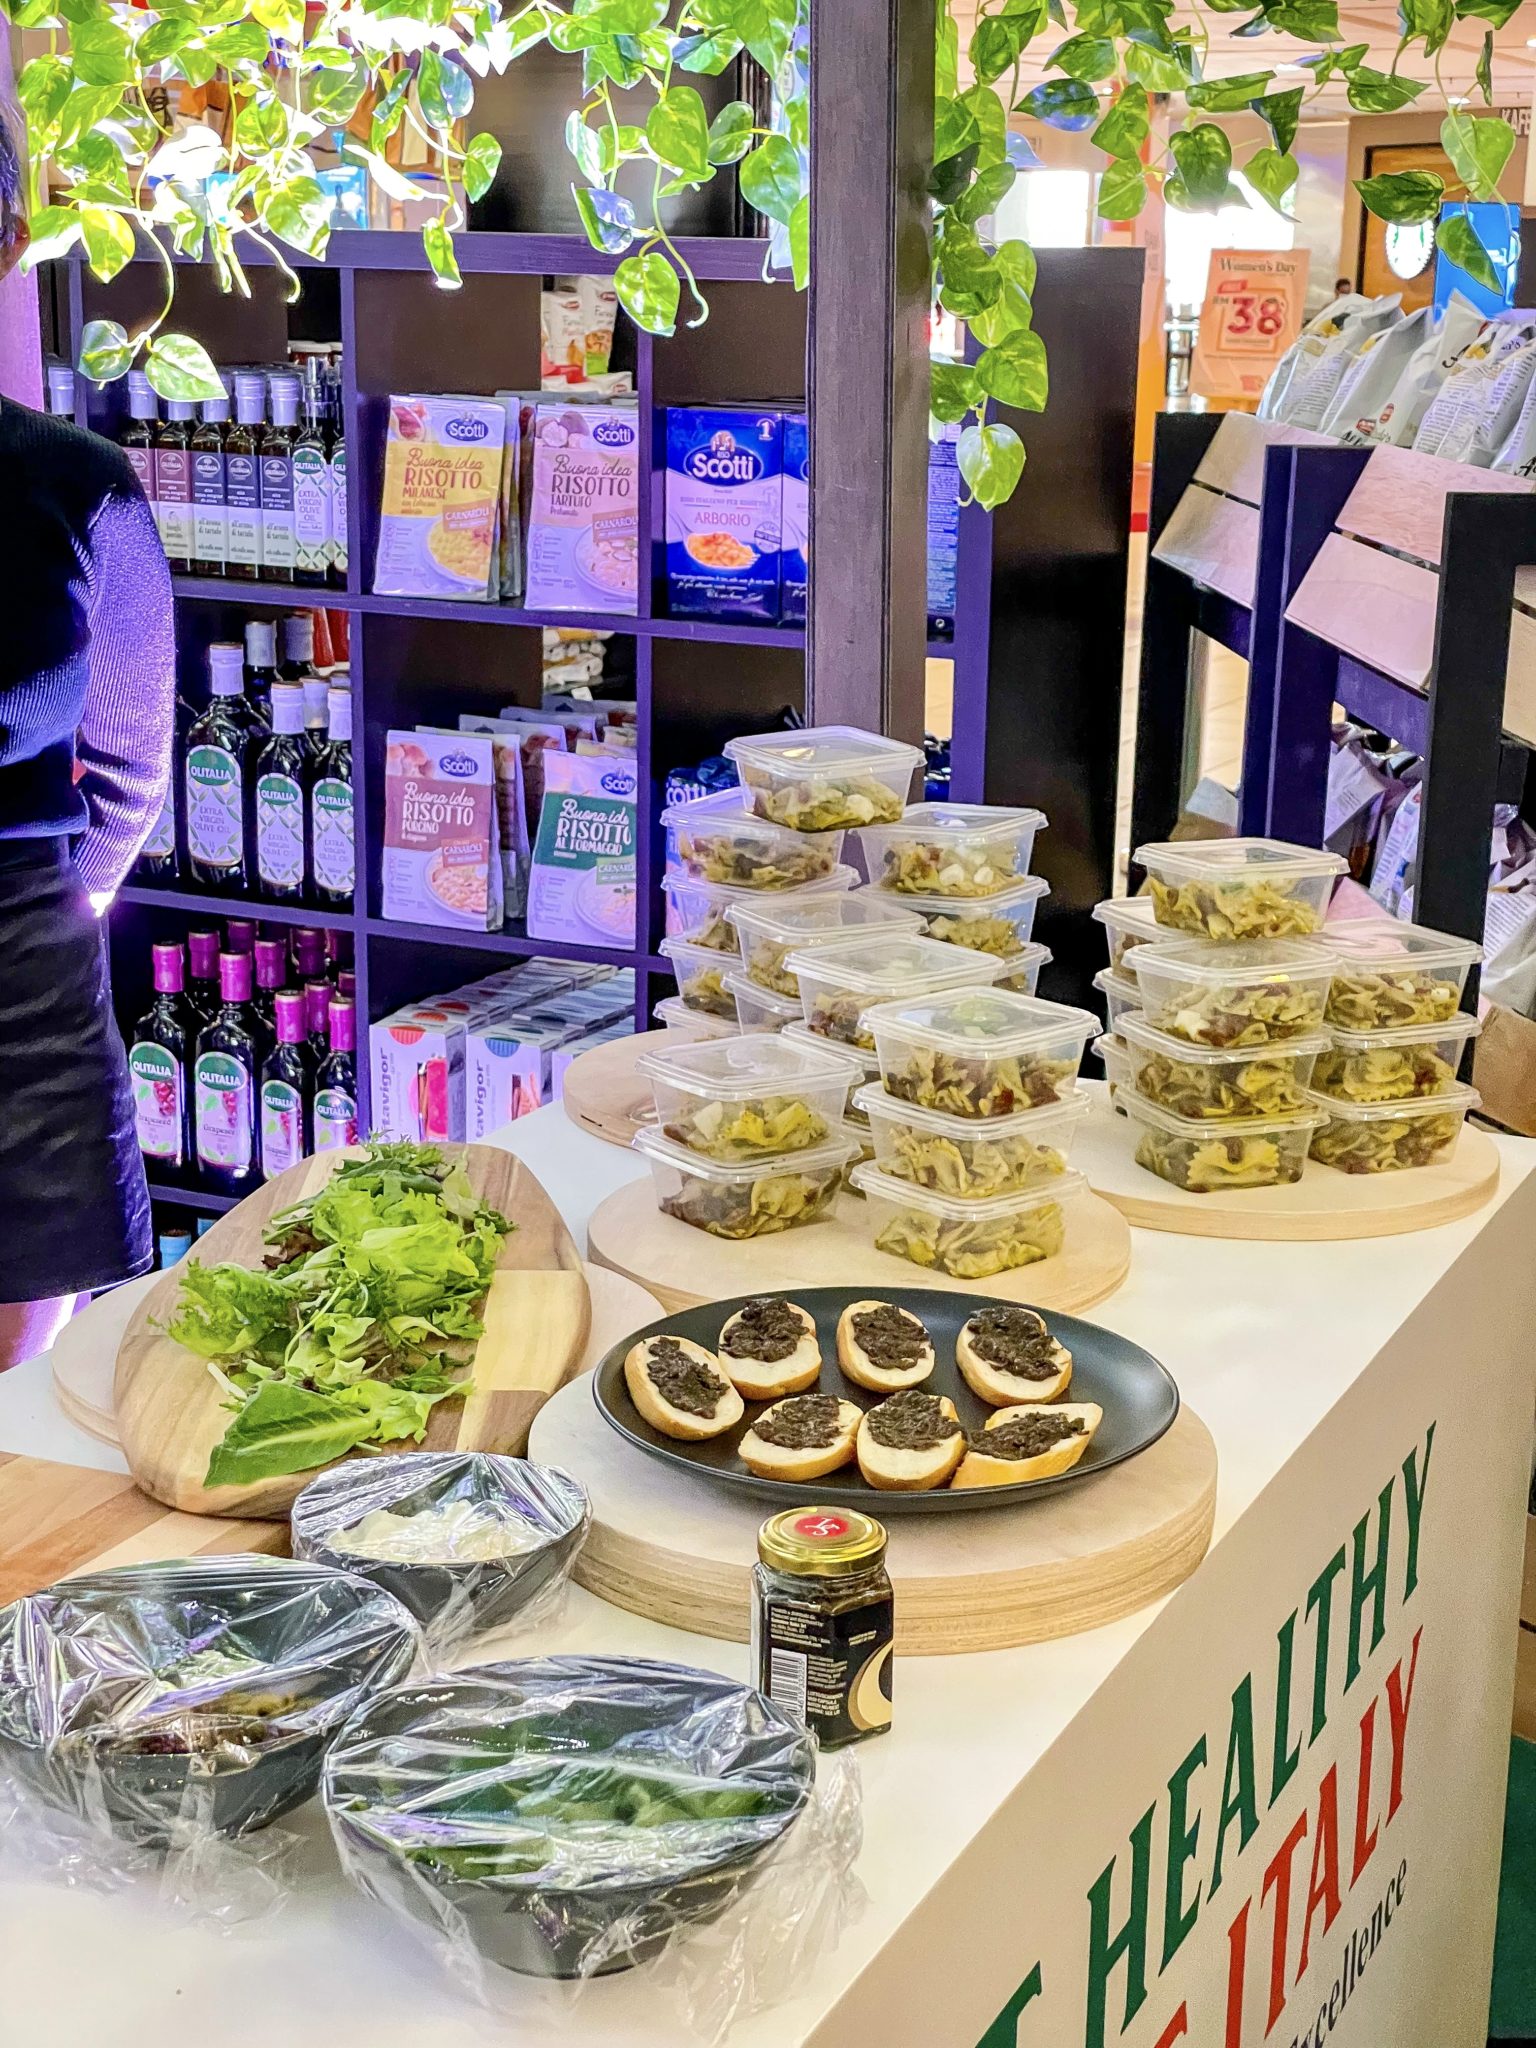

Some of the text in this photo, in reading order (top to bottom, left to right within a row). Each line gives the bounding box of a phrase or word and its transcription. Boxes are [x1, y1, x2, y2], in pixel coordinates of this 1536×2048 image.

[1220, 258, 1297, 276] Women's Day
[1227, 297, 1283, 335] 38
[449, 422, 485, 438] Scotti
[596, 428, 631, 443] Scotti
[406, 447, 485, 470] Buona idea
[553, 454, 632, 476] Buona idea
[692, 453, 754, 481] Scotti
[404, 467, 482, 490] RISOTTO
[551, 474, 630, 497] RISOTTO
[298, 490, 320, 498] EXTRA
[402, 487, 447, 500] MILANESE
[551, 494, 592, 508] TARTUFO
[298, 498, 321, 506] VIRGIN
[300, 506, 320, 515] OLIVE
[694, 511, 752, 527] ARBORIO
[190, 765, 232, 780] OLITALIA
[443, 759, 475, 775] Scotti
[261, 789, 296, 801] OLITALIA
[317, 795, 351, 807] OLITALIA
[404, 782, 475, 807] Buona idea
[200, 806, 224, 816] EXTRA
[402, 801, 474, 826] RISOTTO
[560, 798, 607, 822] Buona
[194, 822, 215, 833] OLIVE
[200, 815, 225, 825] VIRGIN
[402, 820, 439, 834] PORCINO
[556, 817, 632, 845] RISOTTO
[554, 837, 567, 849] AL
[569, 838, 623, 856] FORMAGGIO
[132, 1061, 172, 1076] OLITALIA
[200, 1071, 240, 1086] OLITALIA
[264, 1095, 294, 1106] OLITALIA
[317, 1104, 351, 1117] OLITALIA
[1085, 1420, 1437, 2048] HEALTHY
[1224, 1625, 1424, 2048] ITALY
[1289, 1858, 1407, 2048] cellence
